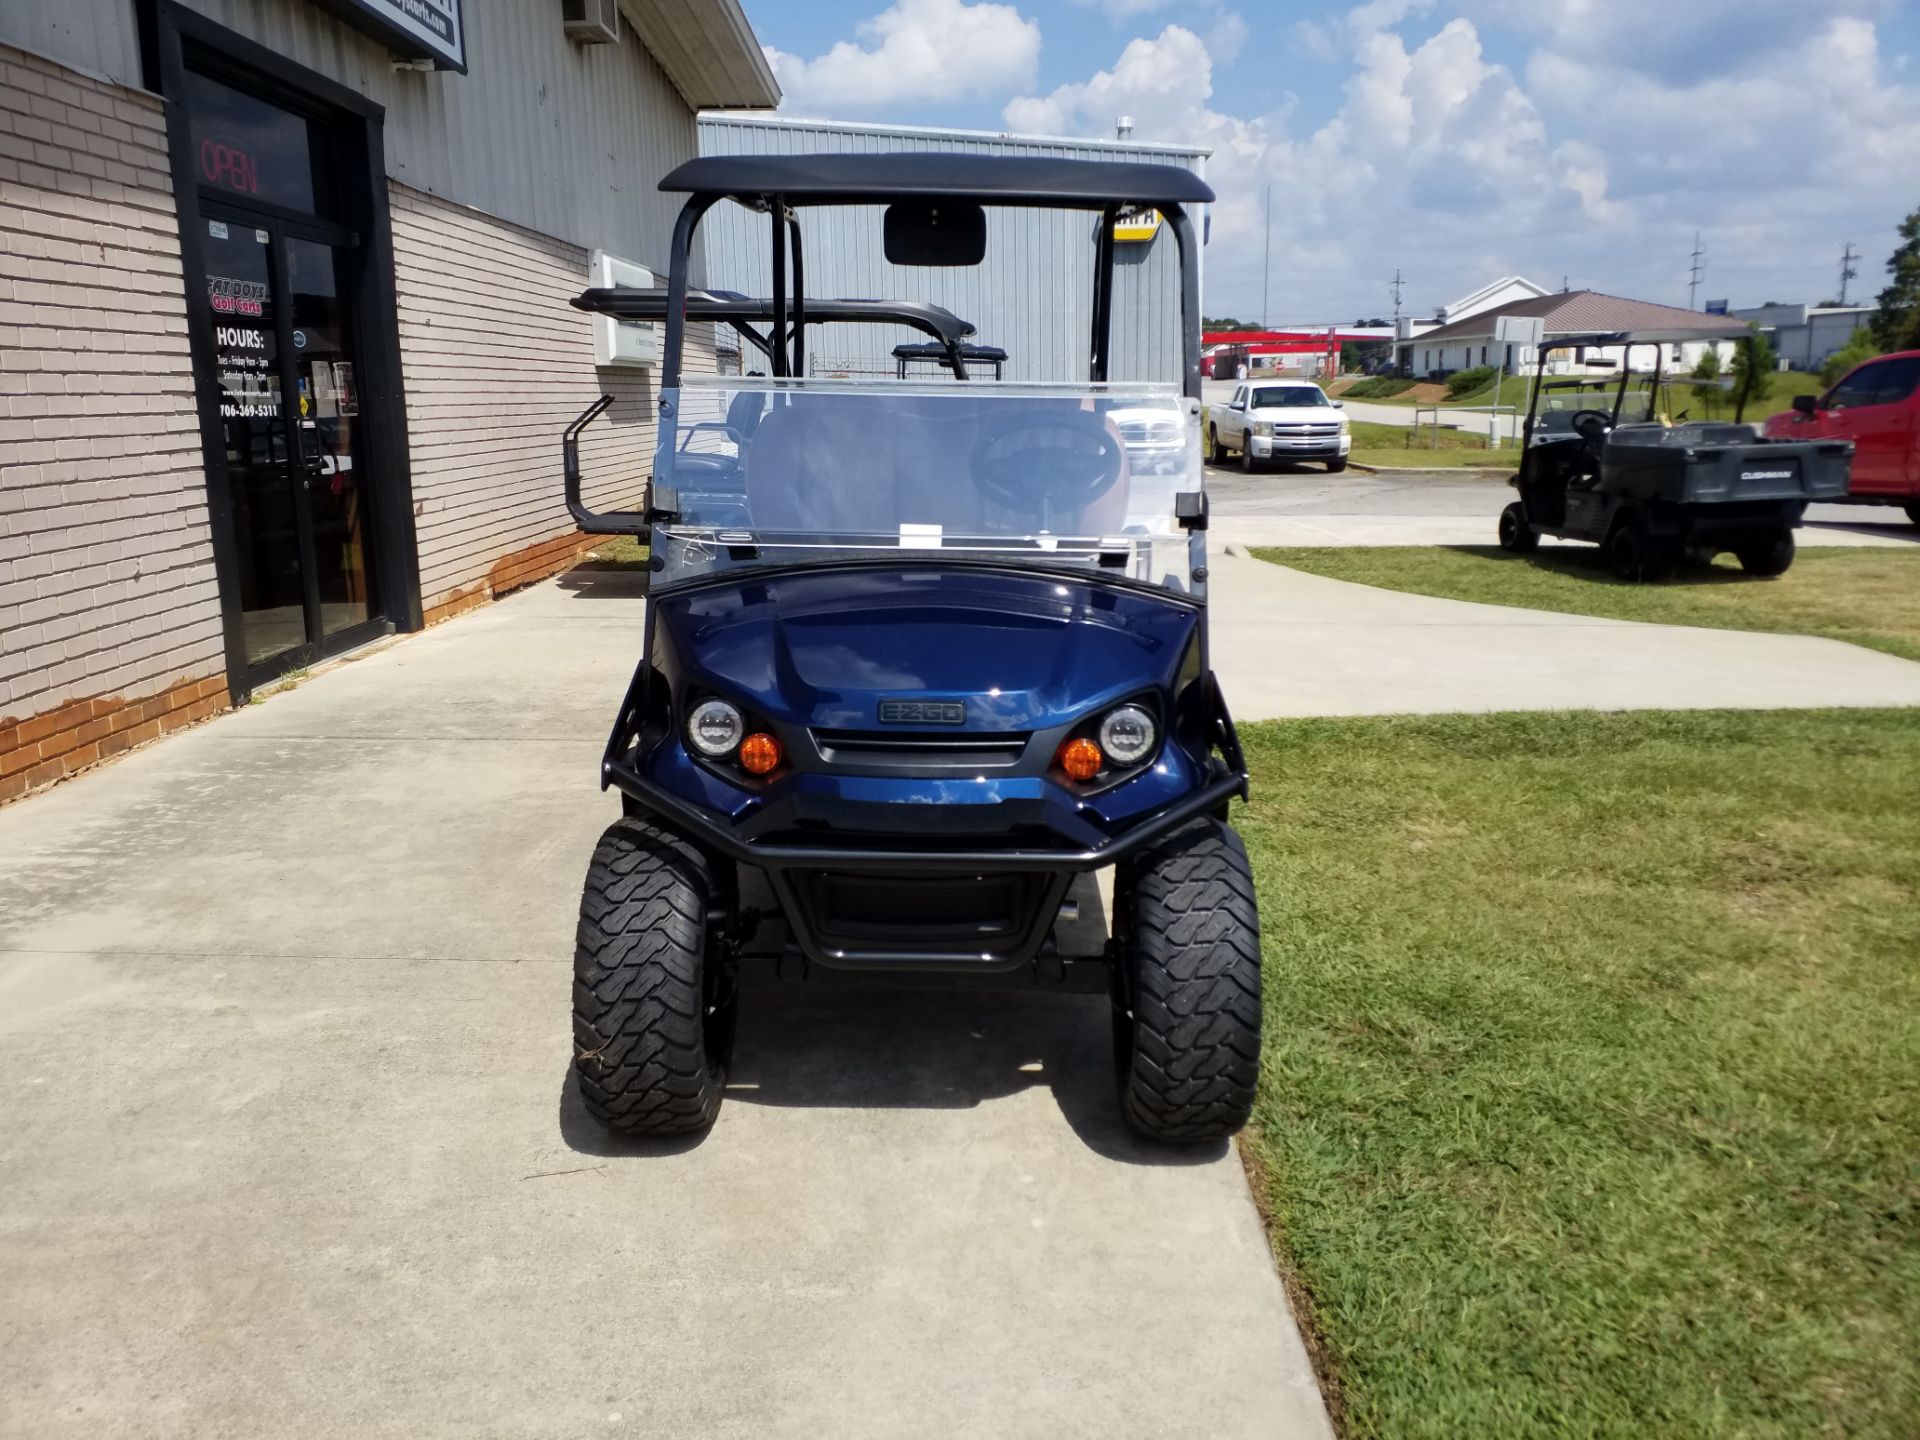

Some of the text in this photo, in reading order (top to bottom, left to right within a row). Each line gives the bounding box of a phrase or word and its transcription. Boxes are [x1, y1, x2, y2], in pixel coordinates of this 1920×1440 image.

[201, 138, 257, 194] OPEN
[231, 279, 266, 301] BOYS
[212, 294, 262, 316] Golf Carts
[217, 326, 264, 348] HOURS:
[220, 405, 277, 417] 706-369-5311
[1741, 471, 1792, 480] CUSHMAN
[881, 703, 962, 722] EZGO
